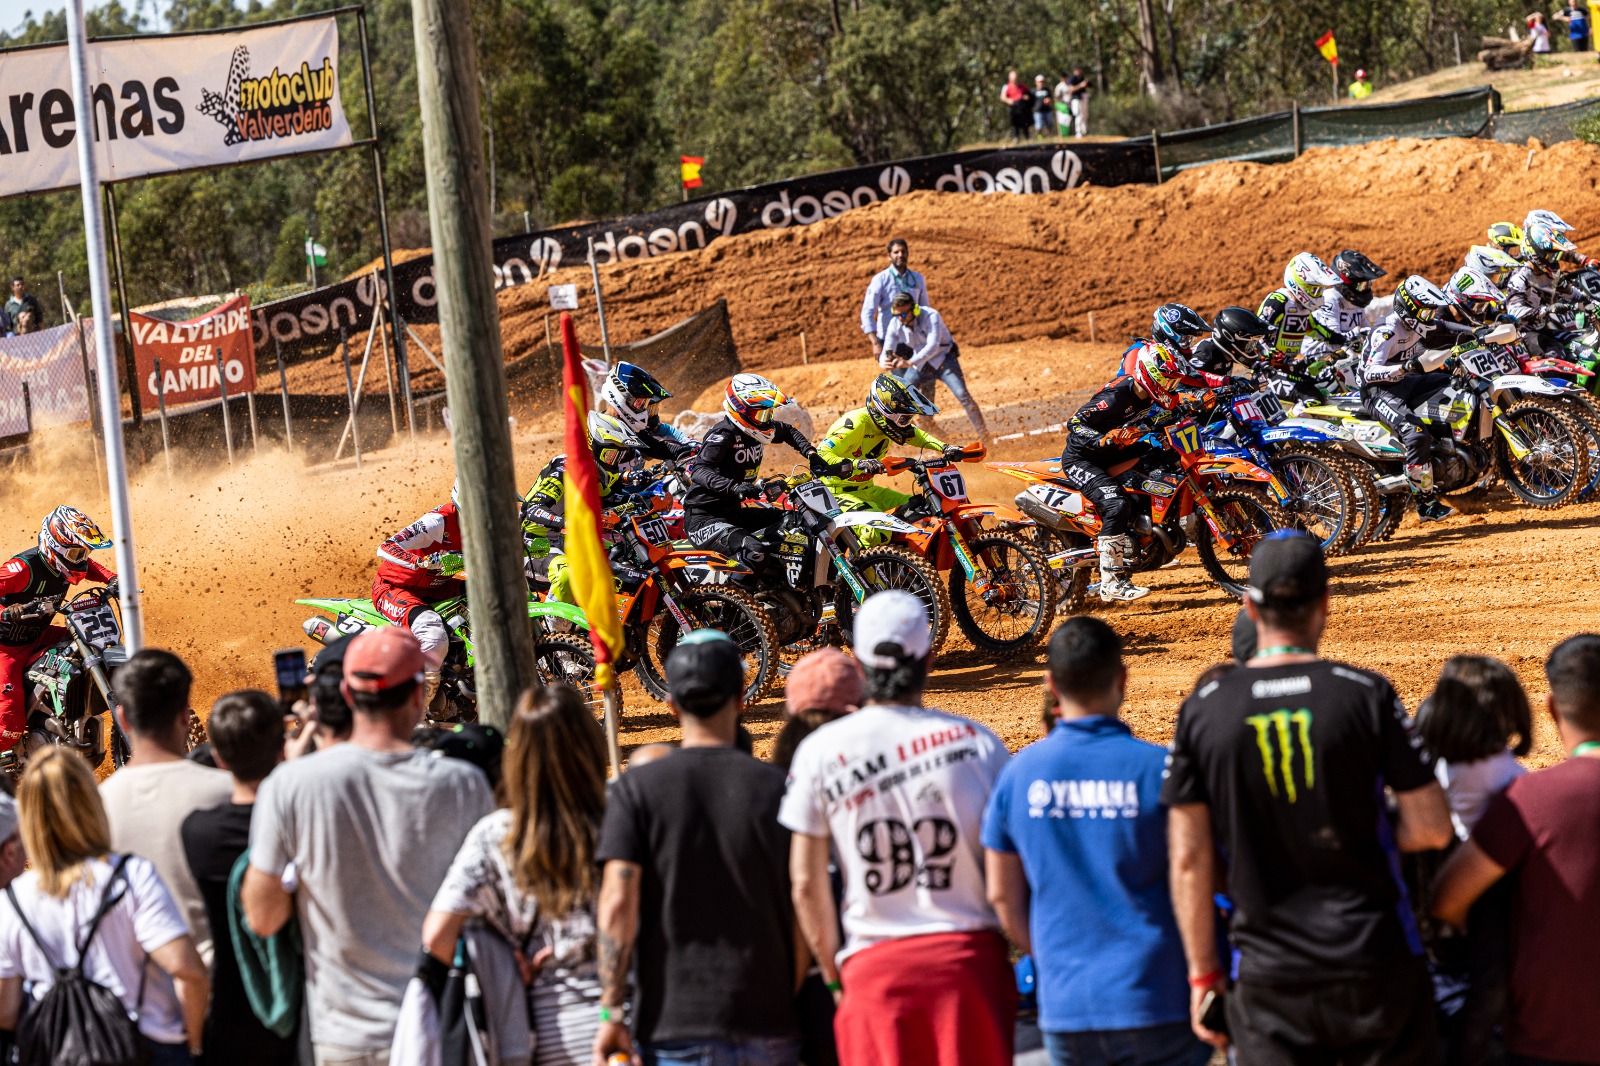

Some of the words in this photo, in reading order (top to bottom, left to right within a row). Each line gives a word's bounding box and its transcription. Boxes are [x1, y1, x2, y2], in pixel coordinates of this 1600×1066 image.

[240, 57, 335, 111] motoclub
[0, 76, 185, 155] renas
[236, 102, 332, 141] Valverdeño
[1399, 281, 1418, 312] LEATT
[131, 305, 249, 346] VALVERDE
[1285, 316, 1309, 332] FX
[179, 344, 214, 364] DEL
[1470, 353, 1499, 374] 124
[148, 359, 244, 395] CAMINO
[1374, 398, 1399, 423] LEATT
[1175, 424, 1200, 455] 17
[939, 473, 965, 497] 67
[1066, 464, 1097, 485] FLY
[811, 487, 833, 511] 7
[1043, 487, 1072, 508] 17
[954, 547, 973, 574] MOTOREX
[841, 566, 863, 593] MOTOREX
[81, 612, 118, 642] 25
[825, 754, 888, 803] TEAM
[1050, 779, 1140, 810] YAMAHA
